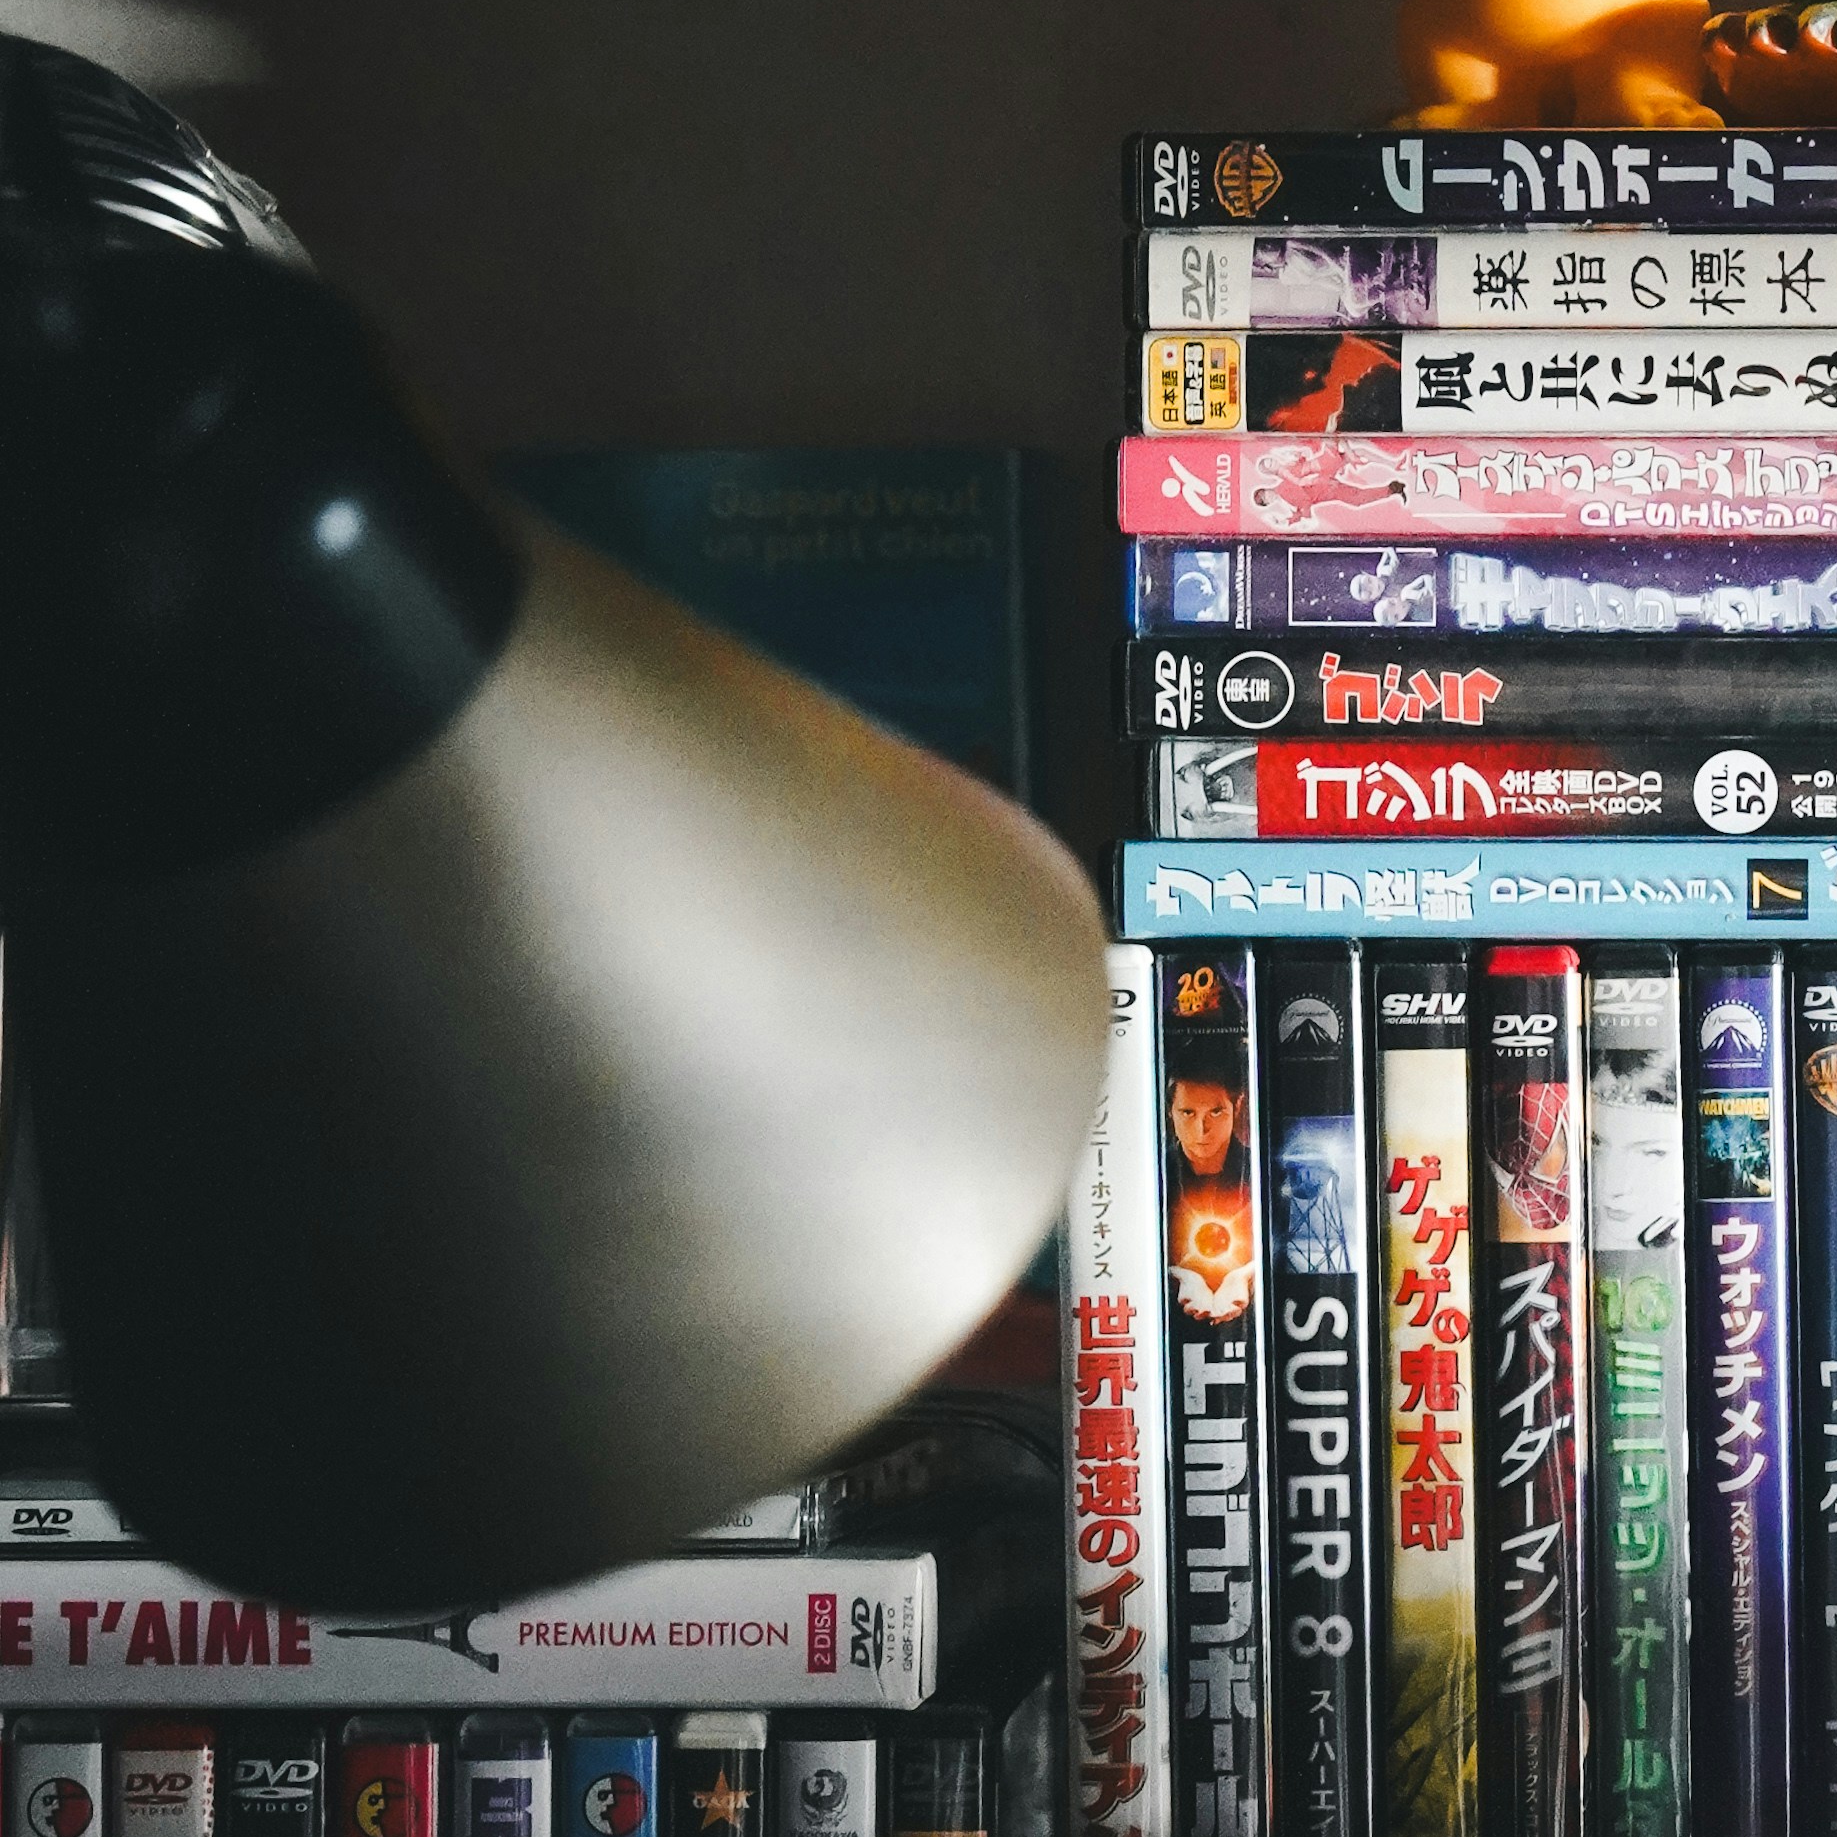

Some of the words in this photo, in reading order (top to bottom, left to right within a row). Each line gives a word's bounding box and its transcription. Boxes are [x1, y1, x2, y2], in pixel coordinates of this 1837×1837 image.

[1153, 139, 1175, 218] DVD
[1472, 246, 1826, 314] 薬指の標本
[1162, 370, 1179, 423] 日本語
[1216, 453, 1232, 514] HERALD
[1154, 649, 1178, 729] DVD
[1224, 676, 1272, 703] 東宝
[1318, 651, 1503, 726] ゴジラ
[1296, 757, 1497, 822] ゴジラ
[1500, 769, 1663, 796] 全映画DVD
[1500, 795, 1663, 815] コレクターズBOX
[1709, 764, 1730, 818] VOL.
[1736, 771, 1767, 817] 52
[1146, 854, 1482, 921] ウルトラ怪獣
[1489, 876, 1735, 906] DVDコレクション
[1752, 872, 1804, 908] 7
[1381, 992, 1467, 1016] SHV
[1388, 1154, 1470, 1551] ゲゲゲの鬼太郎
[1710, 1216, 1767, 1494] ウォッチメン
[1284, 1295, 1353, 1580] SUPER
[60, 1601, 312, 1665] T'AIME
[519, 1622, 657, 1647] PREMIUM
[668, 1622, 789, 1647] EDITION
[815, 1596, 832, 1649] DISC
[1288, 1615, 1354, 1659] 8
[815, 1650, 832, 1665] 2
